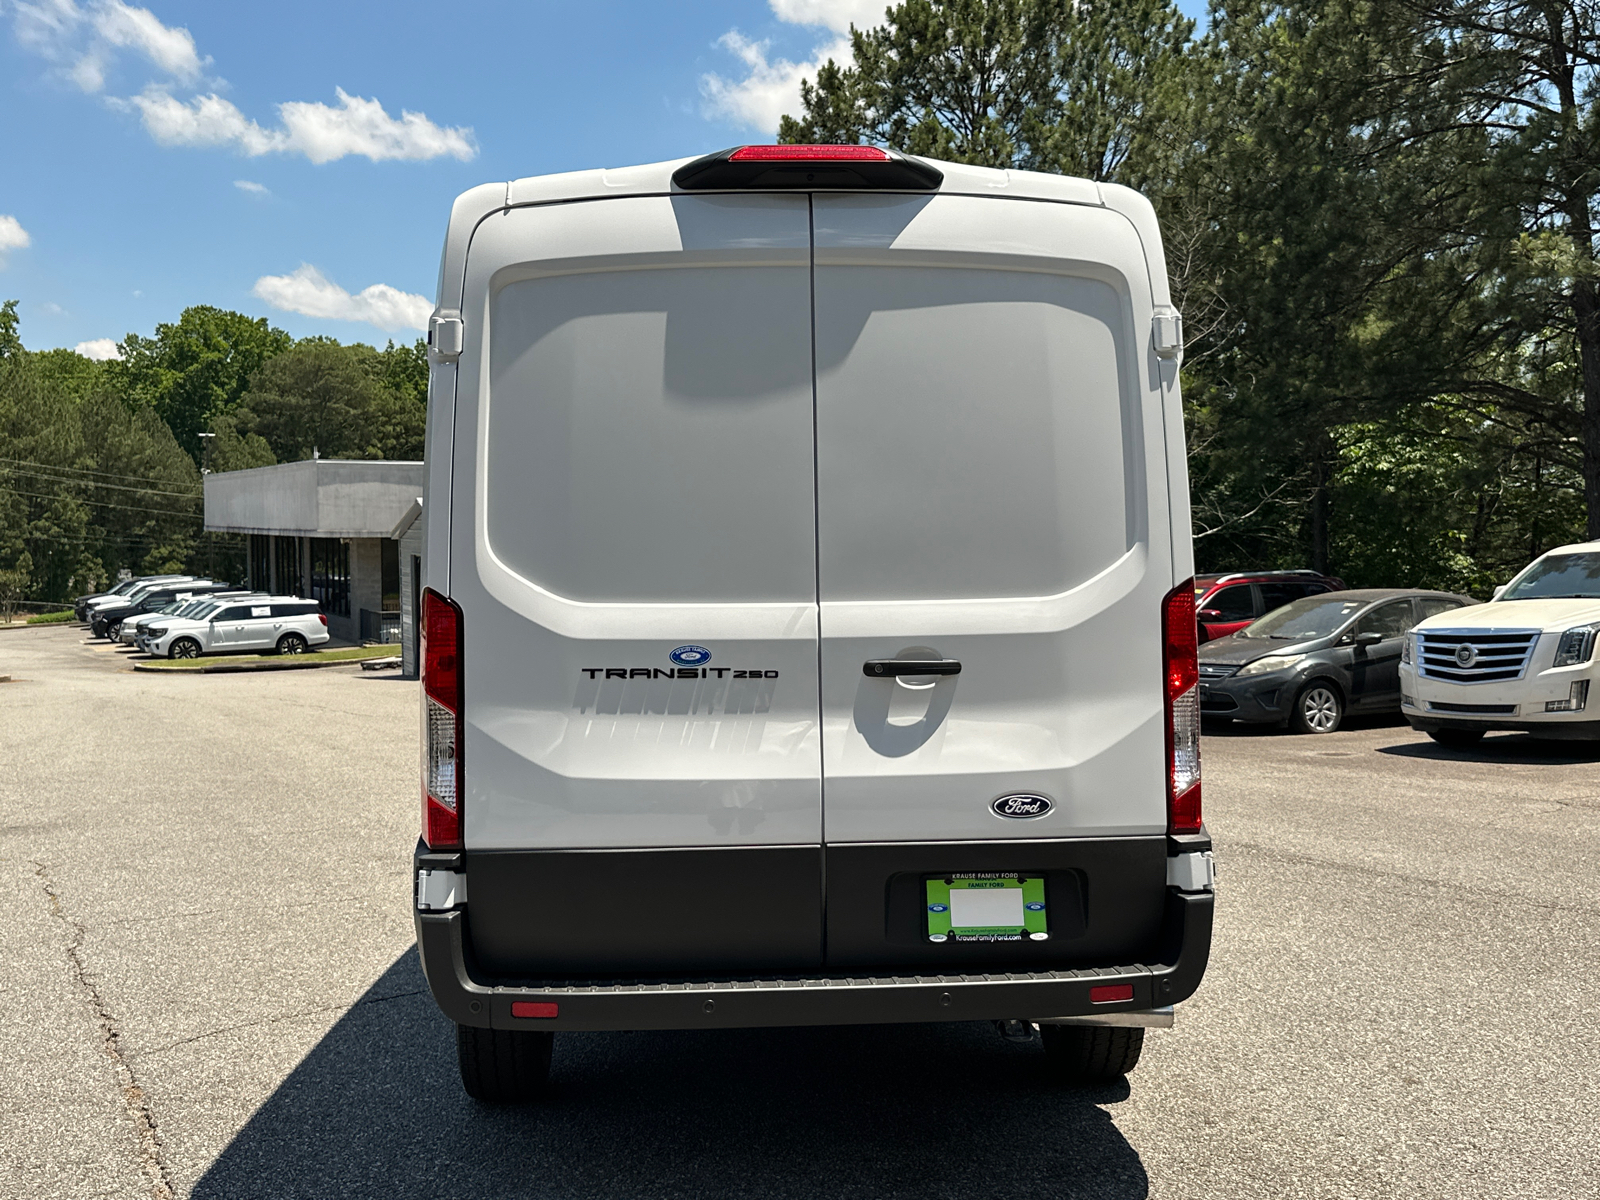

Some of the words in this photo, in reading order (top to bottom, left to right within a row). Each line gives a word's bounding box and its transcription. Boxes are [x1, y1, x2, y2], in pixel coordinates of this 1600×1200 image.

[582, 667, 731, 680] TRANSIT
[733, 670, 779, 679] 250
[1004, 797, 1041, 814] Ford
[955, 933, 1022, 943] KrauseFamilyFord.com
